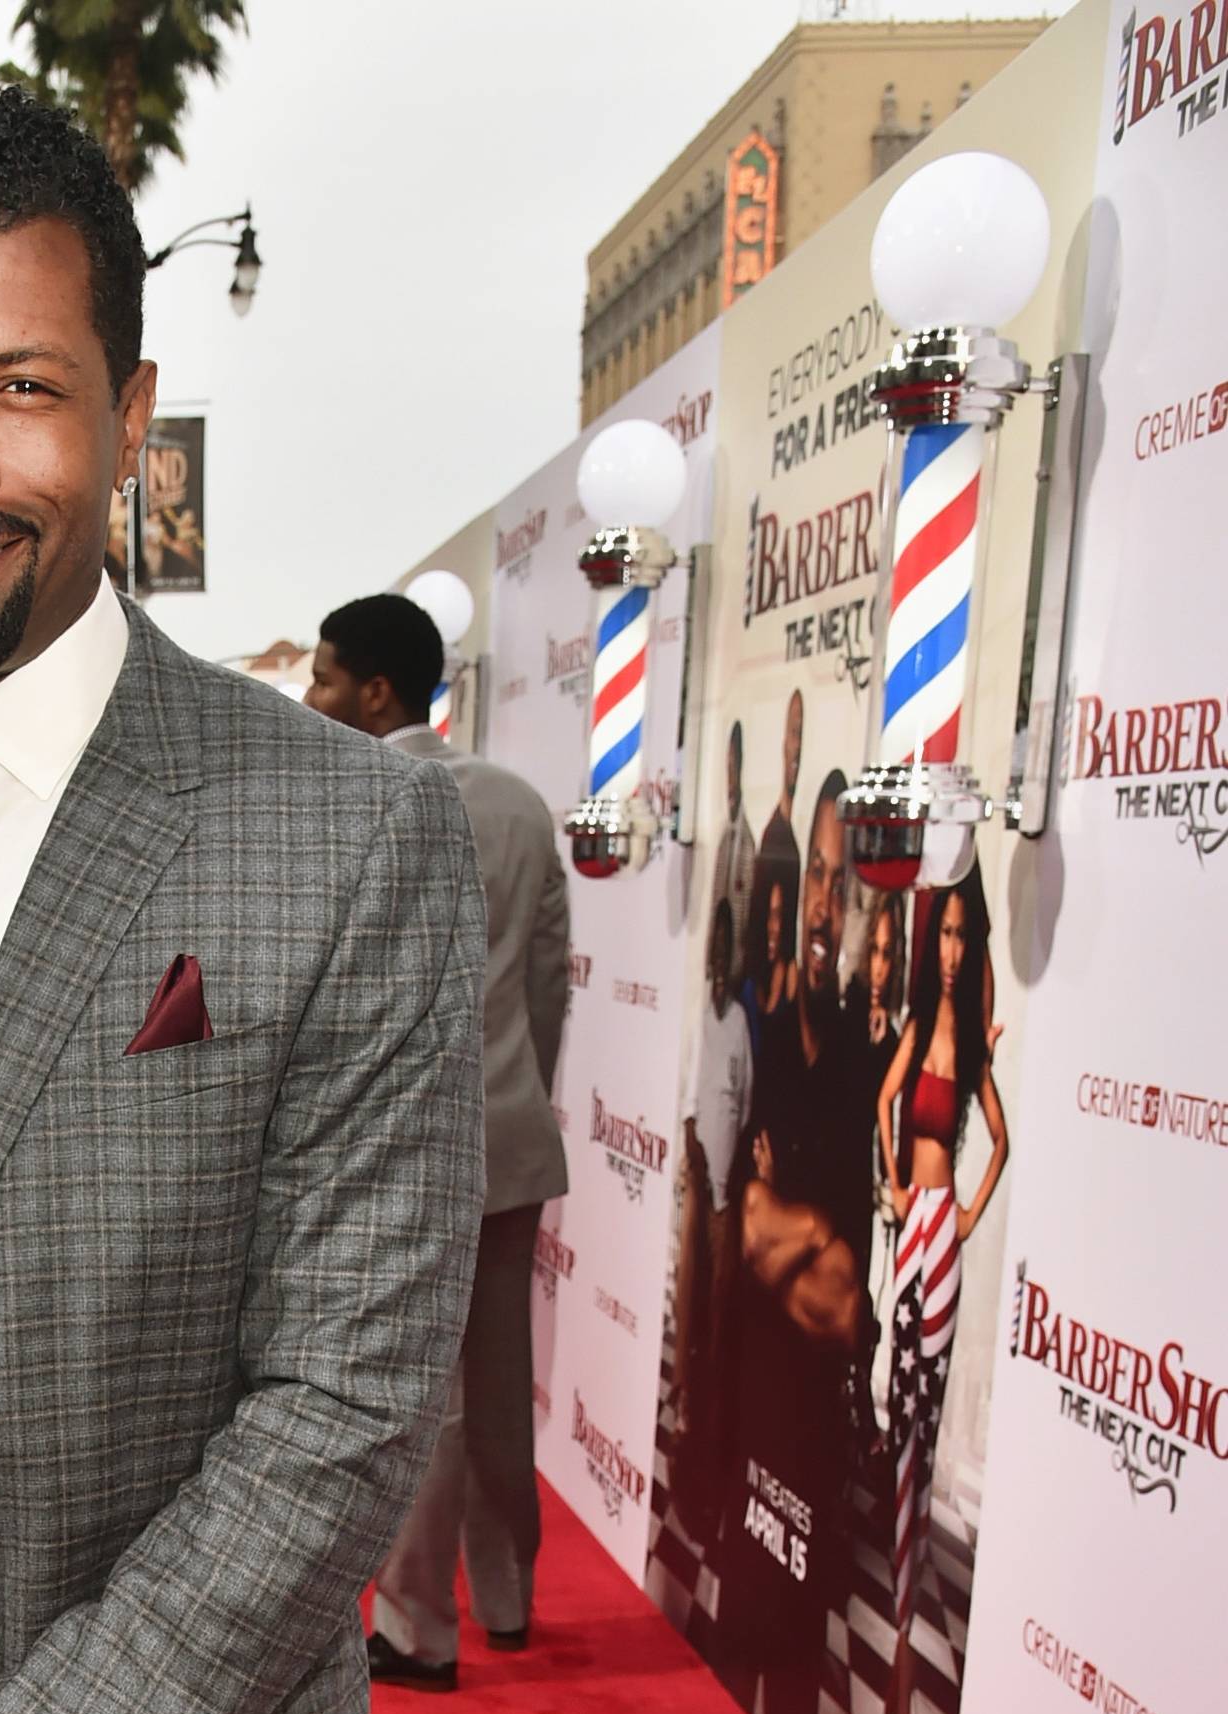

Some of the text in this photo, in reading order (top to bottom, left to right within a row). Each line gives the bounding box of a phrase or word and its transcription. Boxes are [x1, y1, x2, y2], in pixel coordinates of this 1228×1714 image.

[1177, 75, 1220, 139] THE
[768, 298, 899, 418] EVERYBODY
[772, 374, 880, 481] FOR A FRE
[1135, 391, 1208, 461] CREME
[756, 464, 884, 615] BARBER
[785, 617, 815, 663] THE
[817, 600, 865, 656] NEXT
[1116, 784, 1150, 819] THE
[1155, 781, 1210, 820] NEXT
[1077, 1073, 1141, 1124] CREME
[1160, 1090, 1228, 1147] NATURE
[1059, 1385, 1187, 1479] THE NEXT CUT
[744, 1496, 808, 1582] APRIL 15
[1023, 1618, 1080, 1691] CREME
